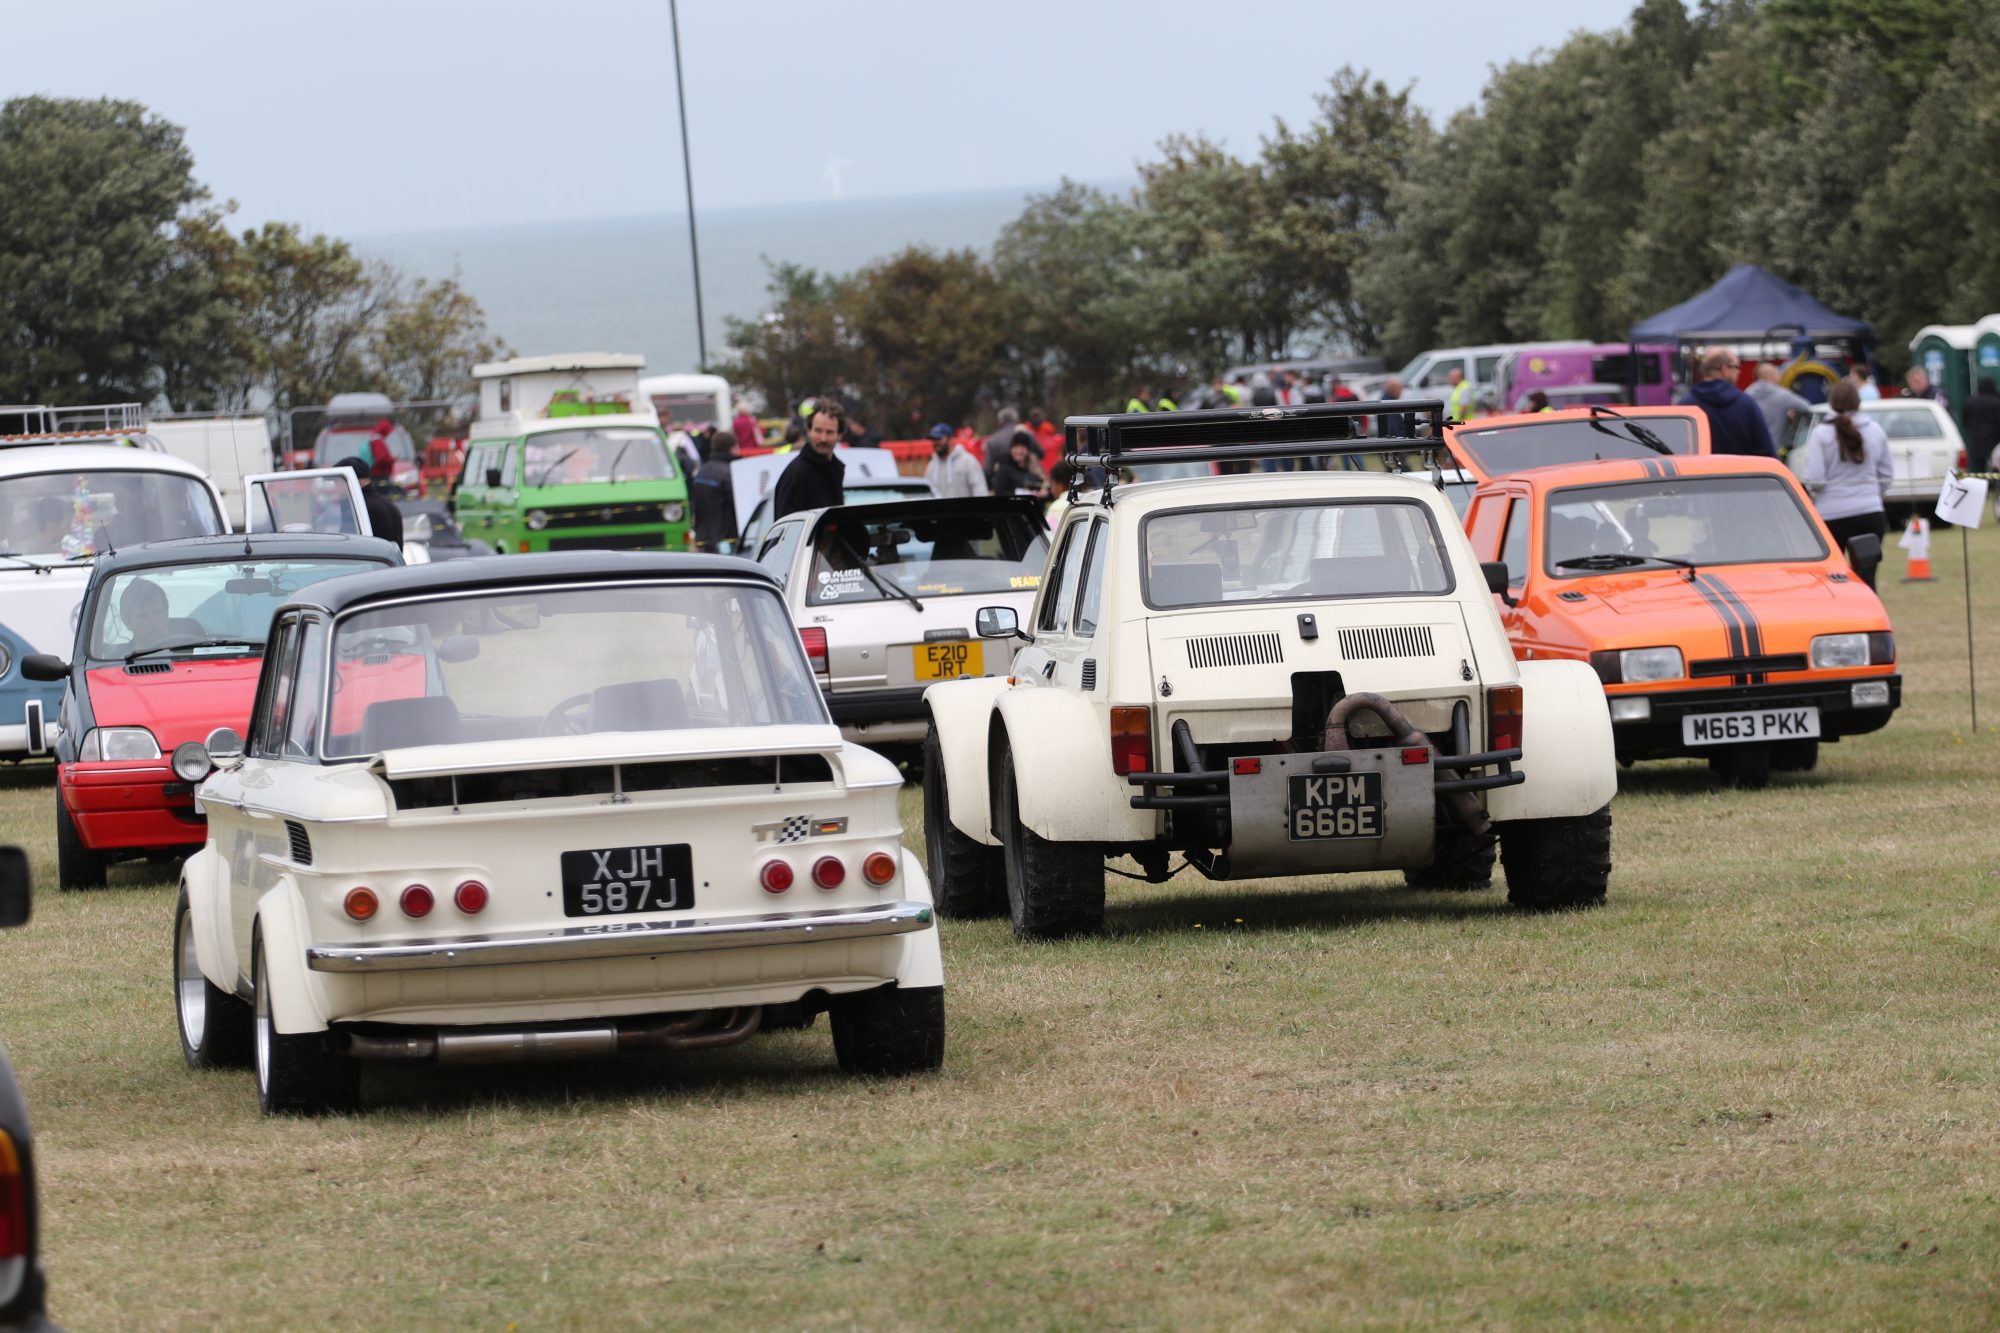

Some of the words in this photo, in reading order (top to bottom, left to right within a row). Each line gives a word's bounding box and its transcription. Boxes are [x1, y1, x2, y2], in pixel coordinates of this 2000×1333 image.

[928, 645, 967, 662] E210
[932, 661, 965, 677] JRT
[1693, 715, 1755, 741] M663
[1762, 712, 1808, 736] PKK
[1306, 775, 1365, 807] KPM
[1296, 805, 1376, 837] 666E
[591, 847, 663, 880] XJH
[582, 878, 677, 913] 587J
